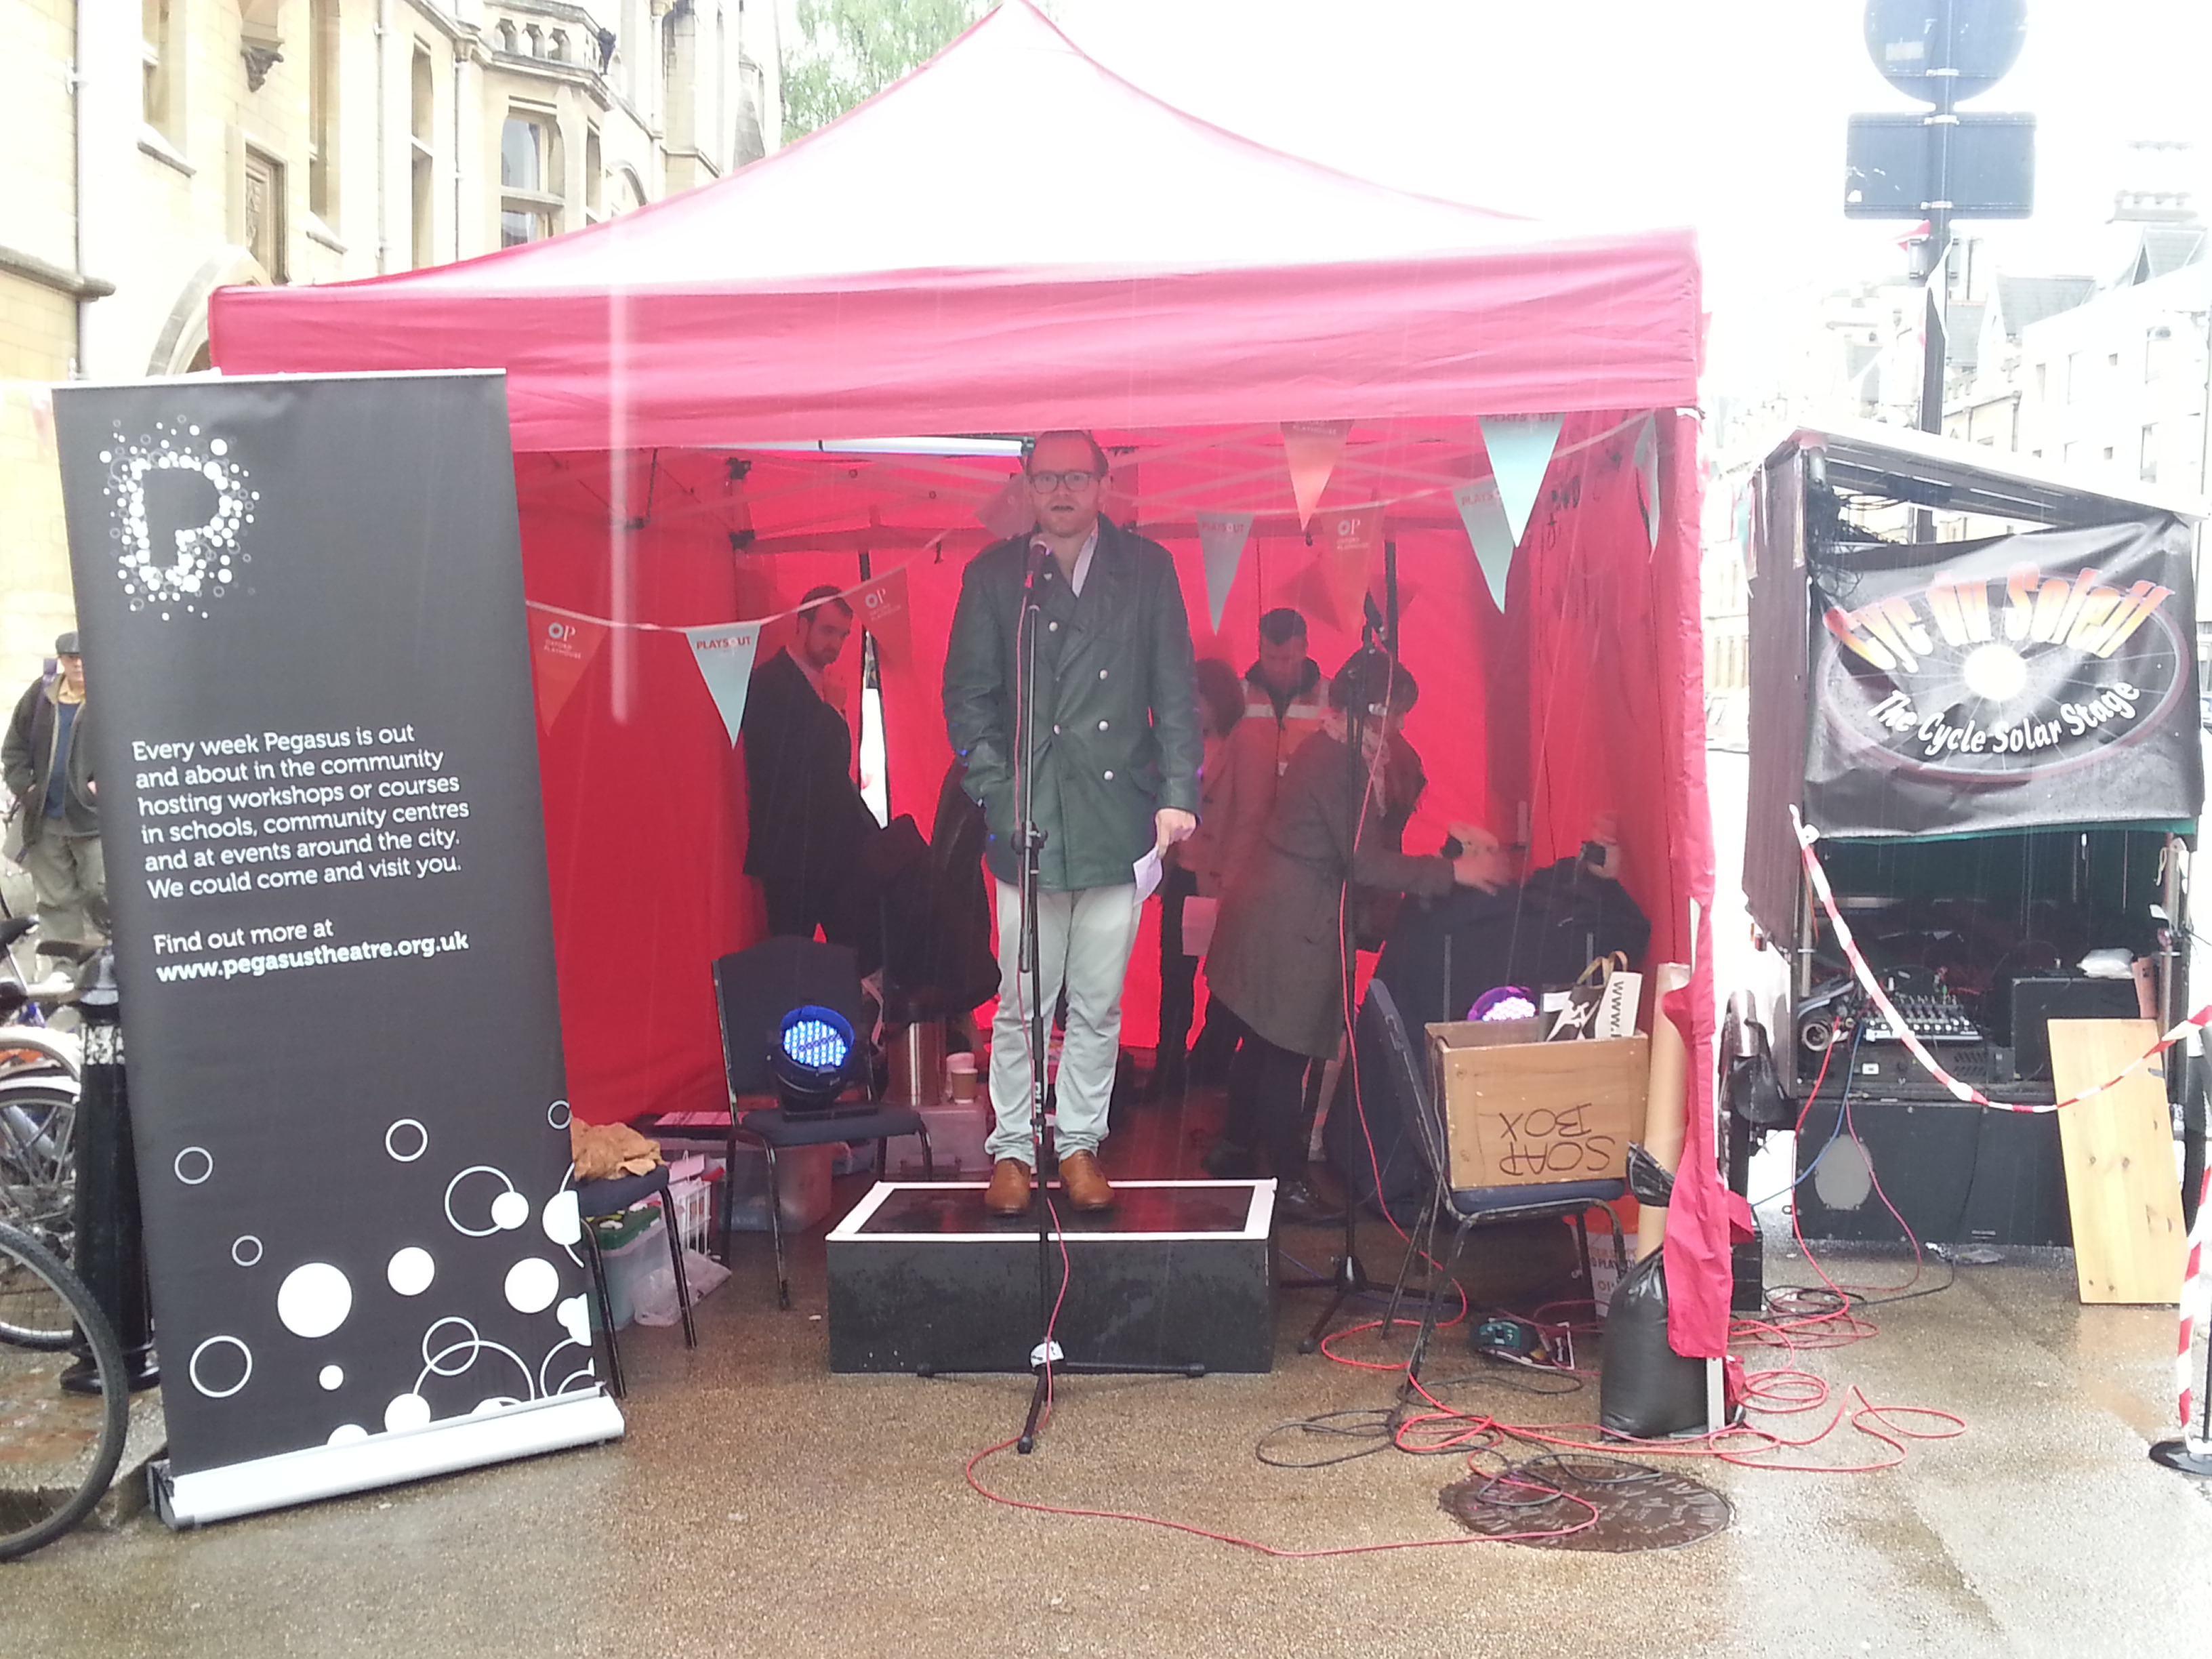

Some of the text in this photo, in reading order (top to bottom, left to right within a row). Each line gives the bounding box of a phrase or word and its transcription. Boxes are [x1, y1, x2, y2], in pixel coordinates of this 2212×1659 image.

[2003, 561, 2174, 659] Soleil
[548, 622, 576, 642] OP
[1867, 682, 2140, 756] The Cycle Solar Stage
[131, 724, 415, 762] Every week Pegasus is out
[136, 748, 444, 790] and about in the community
[137, 777, 459, 817] hosting workshops or courses
[141, 802, 470, 844] in schools, community centres
[145, 827, 459, 872] and at events around the city.
[146, 856, 462, 899] We could come and visit you.
[152, 918, 334, 955] Find out more at
[156, 930, 469, 982] www.pegasustheatre.org.uk
[1499, 1103, 1592, 1142] BOX
[1499, 1135, 1616, 1176] SOAP
